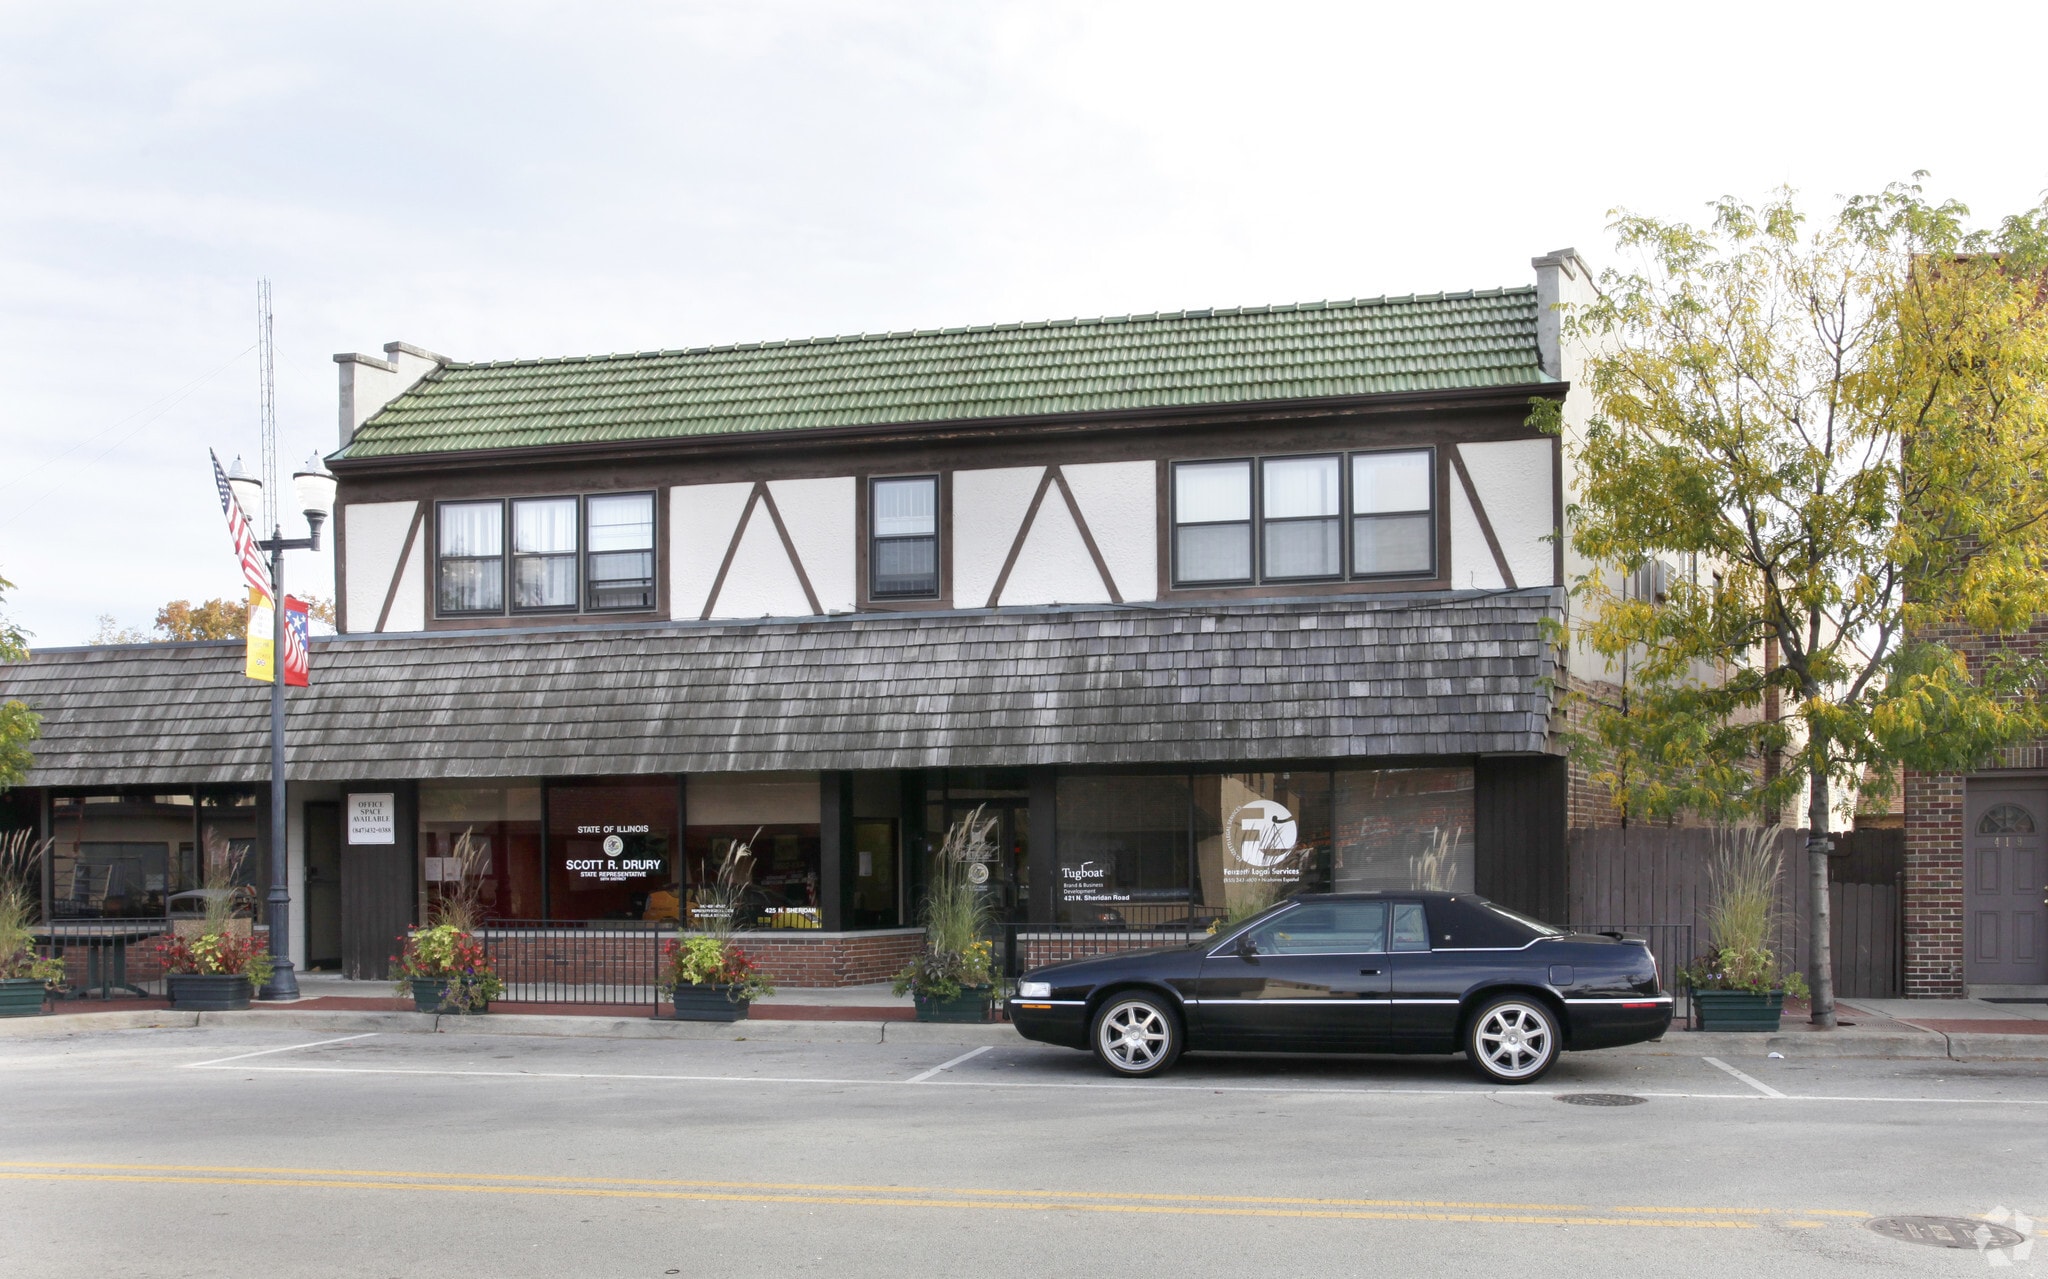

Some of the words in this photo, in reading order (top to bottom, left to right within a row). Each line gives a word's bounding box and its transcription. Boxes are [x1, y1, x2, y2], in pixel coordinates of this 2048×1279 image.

[577, 825, 601, 834] STATE
[603, 825, 615, 833] OF
[616, 824, 649, 833] ILLINOIS
[1994, 836, 2023, 848] 419
[565, 859, 604, 870] SCOTT
[607, 859, 619, 870] R.
[622, 859, 661, 870] DRURY
[1061, 861, 1104, 881] Tugboat
[1251, 867, 1270, 876] Legal
[1271, 867, 1300, 875] Services
